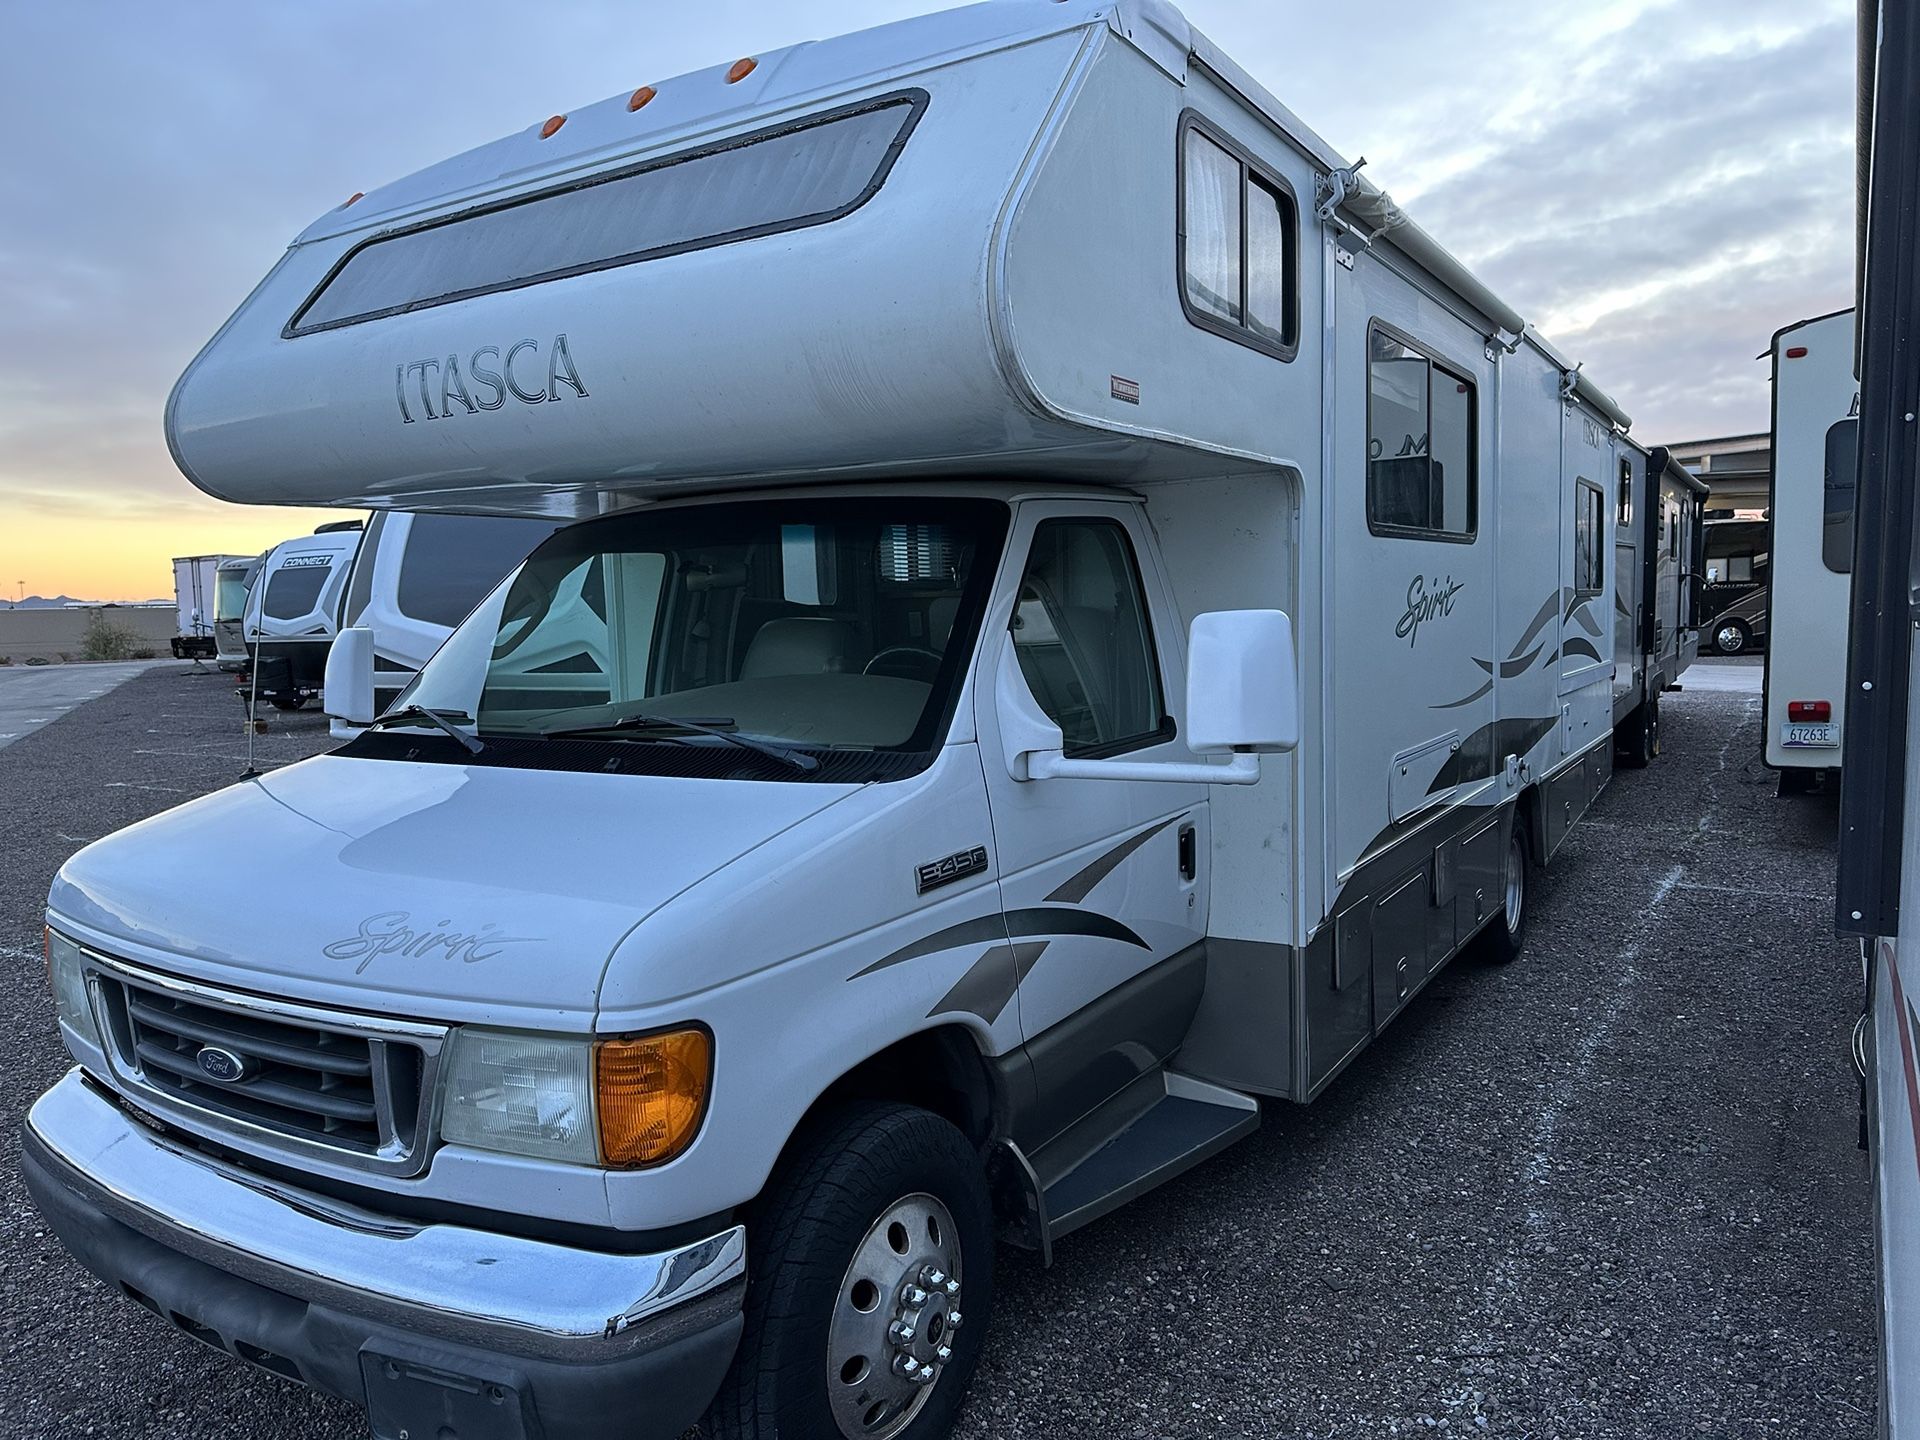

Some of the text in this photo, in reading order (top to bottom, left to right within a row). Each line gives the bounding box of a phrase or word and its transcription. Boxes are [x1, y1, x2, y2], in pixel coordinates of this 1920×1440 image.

[395, 333, 590, 424] ITASCA
[284, 556, 332, 567] CONNECT
[1395, 575, 1465, 649] Spirit
[1789, 728, 1830, 741] 67263E
[322, 911, 549, 975] Spirit
[206, 1053, 230, 1074] Ford
